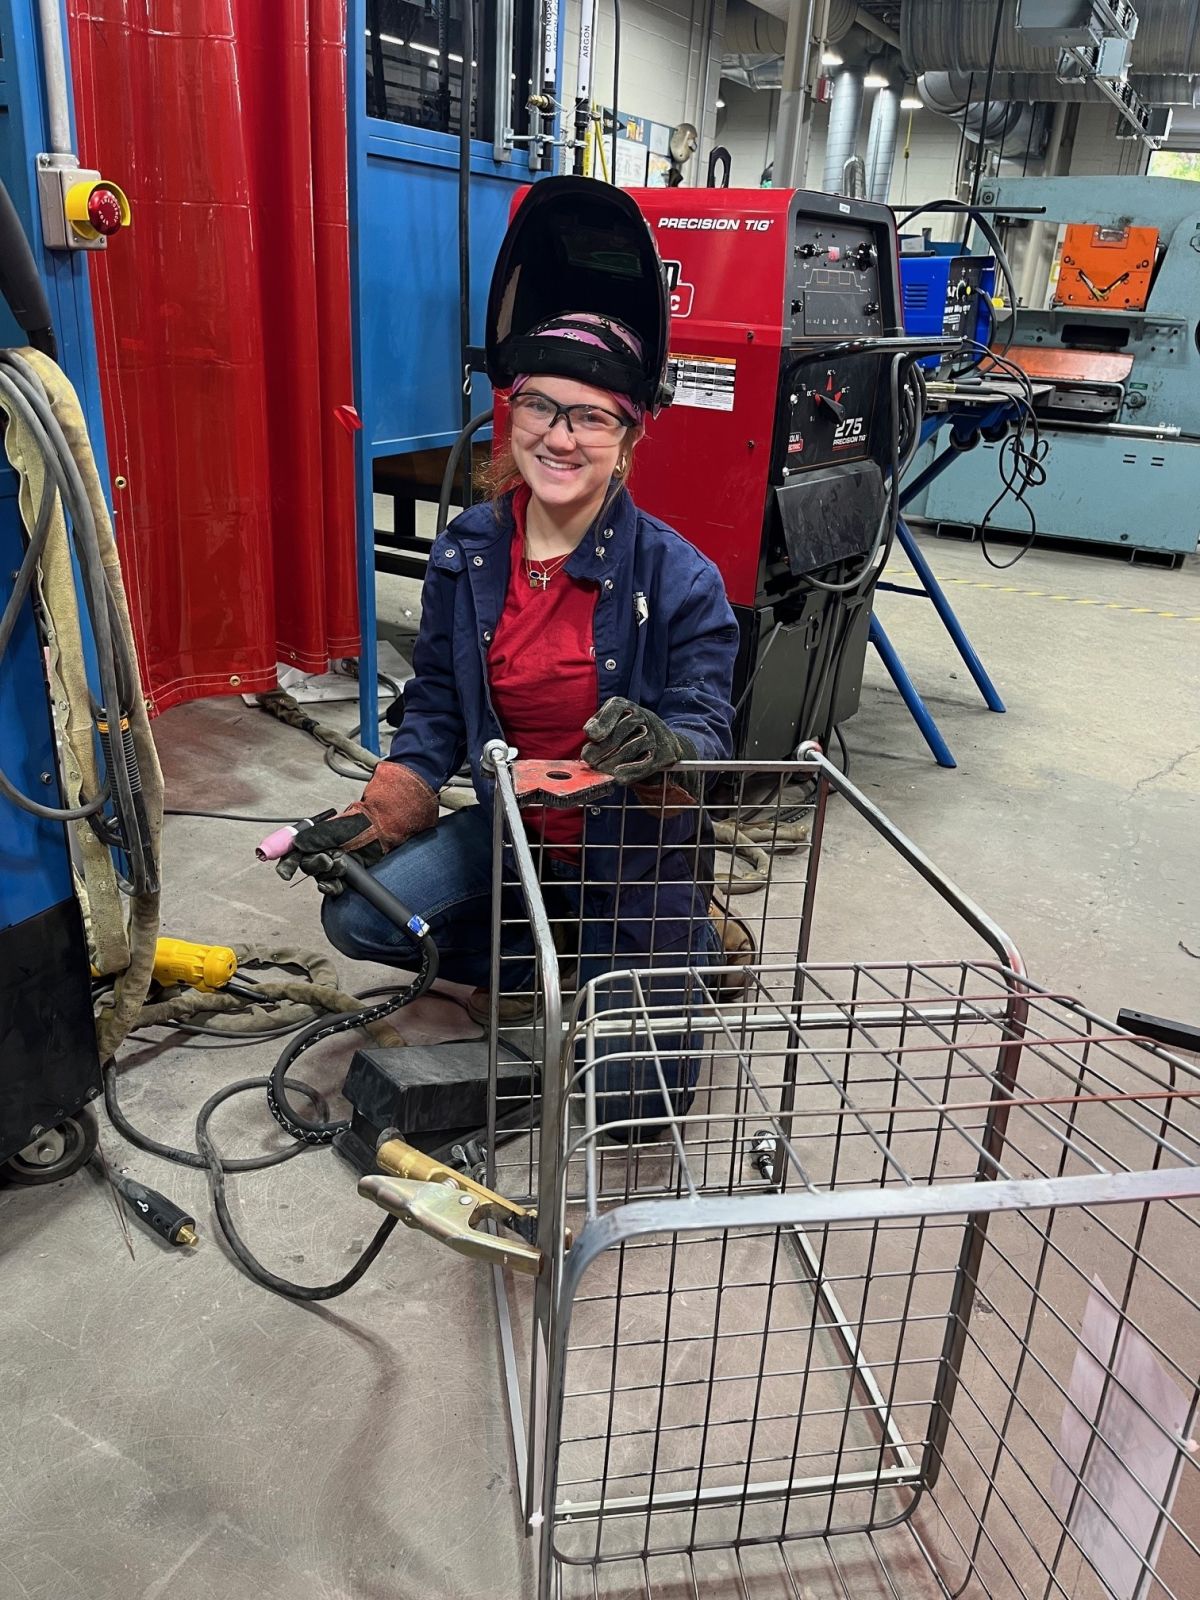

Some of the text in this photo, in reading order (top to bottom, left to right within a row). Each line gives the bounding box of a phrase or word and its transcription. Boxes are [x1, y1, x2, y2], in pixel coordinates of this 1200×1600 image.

[582, 25, 590, 57] ARGON
[658, 217, 741, 230] PRECISION
[834, 417, 863, 437] 275
[832, 437, 858, 446] PRECISION
